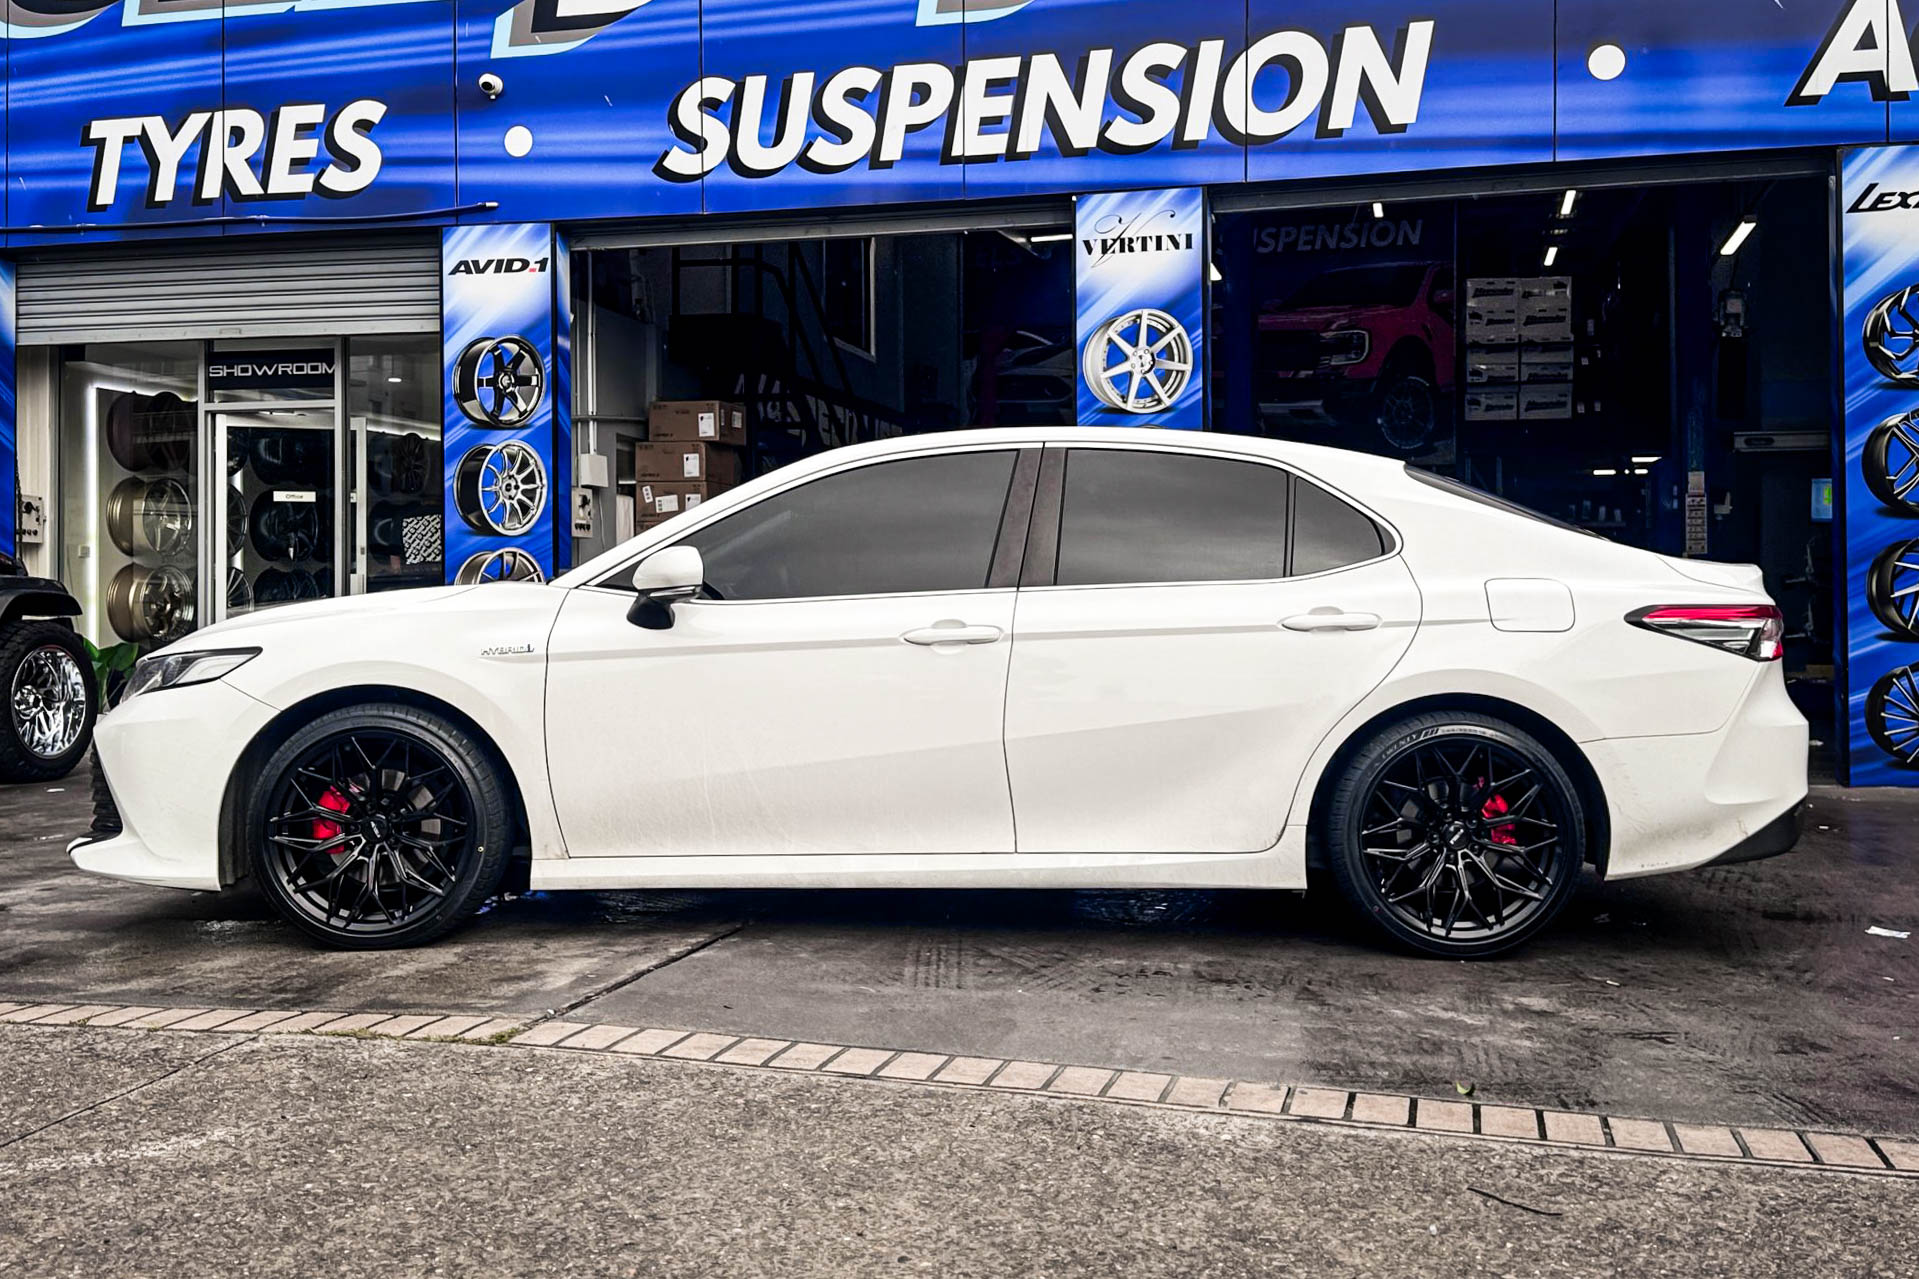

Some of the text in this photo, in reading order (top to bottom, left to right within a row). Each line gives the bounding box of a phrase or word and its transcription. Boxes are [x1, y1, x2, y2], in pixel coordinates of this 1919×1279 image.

[1797, 0, 1919, 98] A
[659, 19, 1436, 177] SUSPENSION
[86, 99, 388, 207] TYRES
[1845, 182, 1919, 213] LEX
[1082, 233, 1193, 255] VERTINI
[447, 257, 549, 275] AVID.1
[209, 362, 336, 377] SHOWROOM
